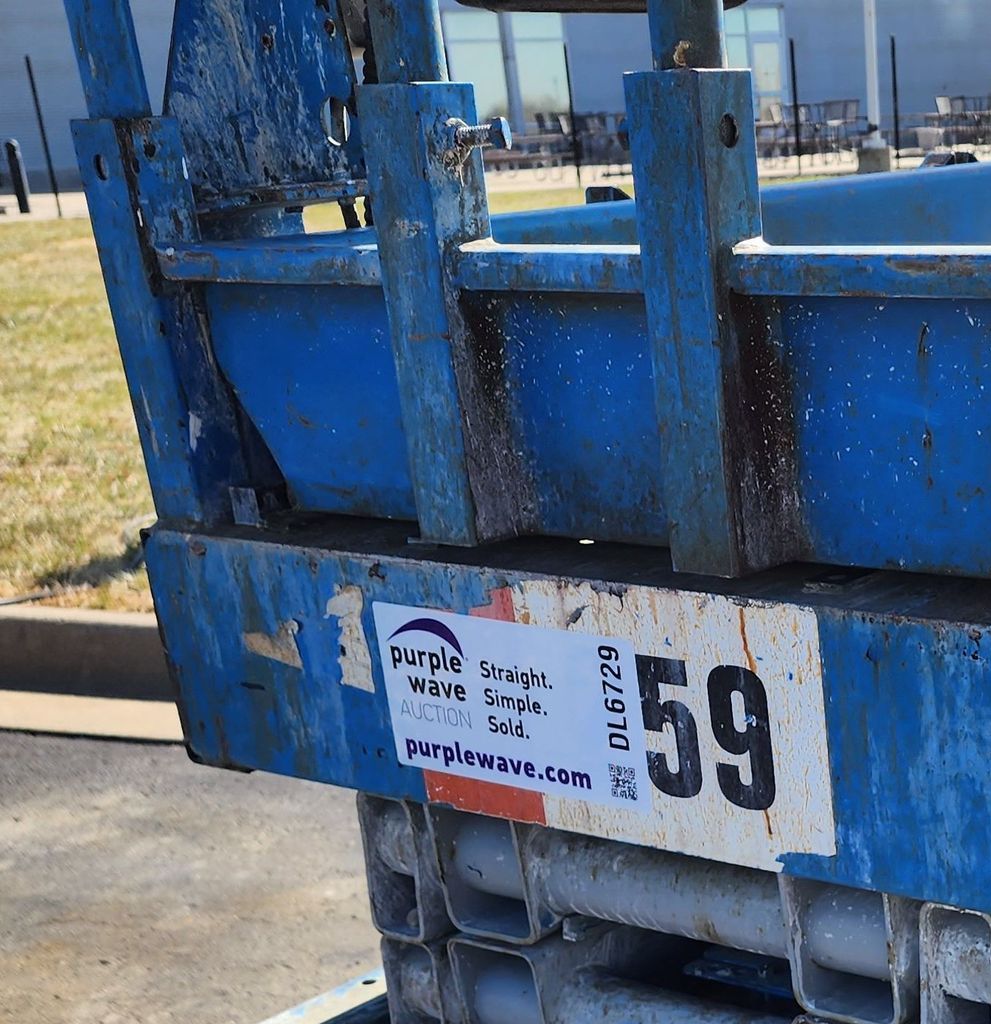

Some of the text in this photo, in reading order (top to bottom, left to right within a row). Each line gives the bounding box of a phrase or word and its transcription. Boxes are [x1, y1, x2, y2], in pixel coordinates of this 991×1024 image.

[390, 643, 463, 674] purple
[407, 675, 467, 702] wave
[479, 660, 553, 691] Straight.
[483, 688, 548, 717] Simple.
[597, 645, 630, 752] DL6729
[400, 699, 472, 730] AUCTION
[488, 716, 530, 740] Sold.
[635, 653, 776, 811] 59
[405, 734, 592, 790] purplewave.com
